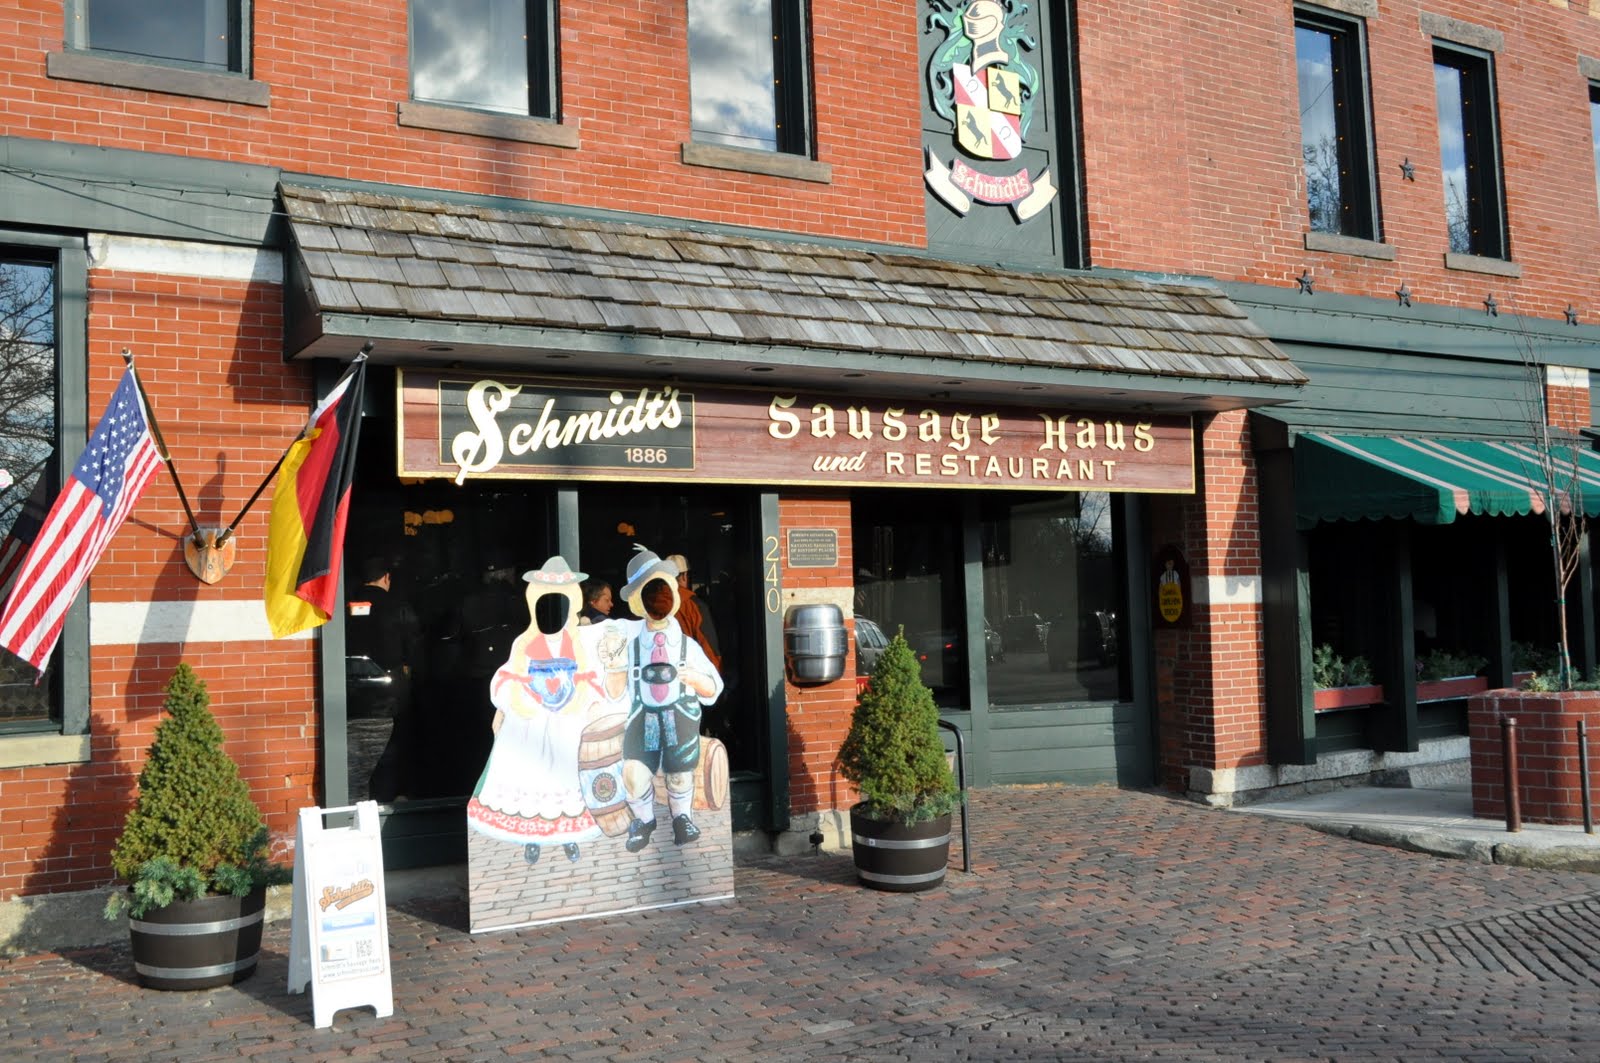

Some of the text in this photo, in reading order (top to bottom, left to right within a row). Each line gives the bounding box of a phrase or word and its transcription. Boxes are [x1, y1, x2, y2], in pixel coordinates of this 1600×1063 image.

[451, 379, 683, 486] Schmidt's
[767, 393, 1156, 453] Sausage Haus
[624, 448, 668, 464] 1886
[812, 450, 1117, 481] und RESTAURANT
[765, 535, 780, 613] 240
